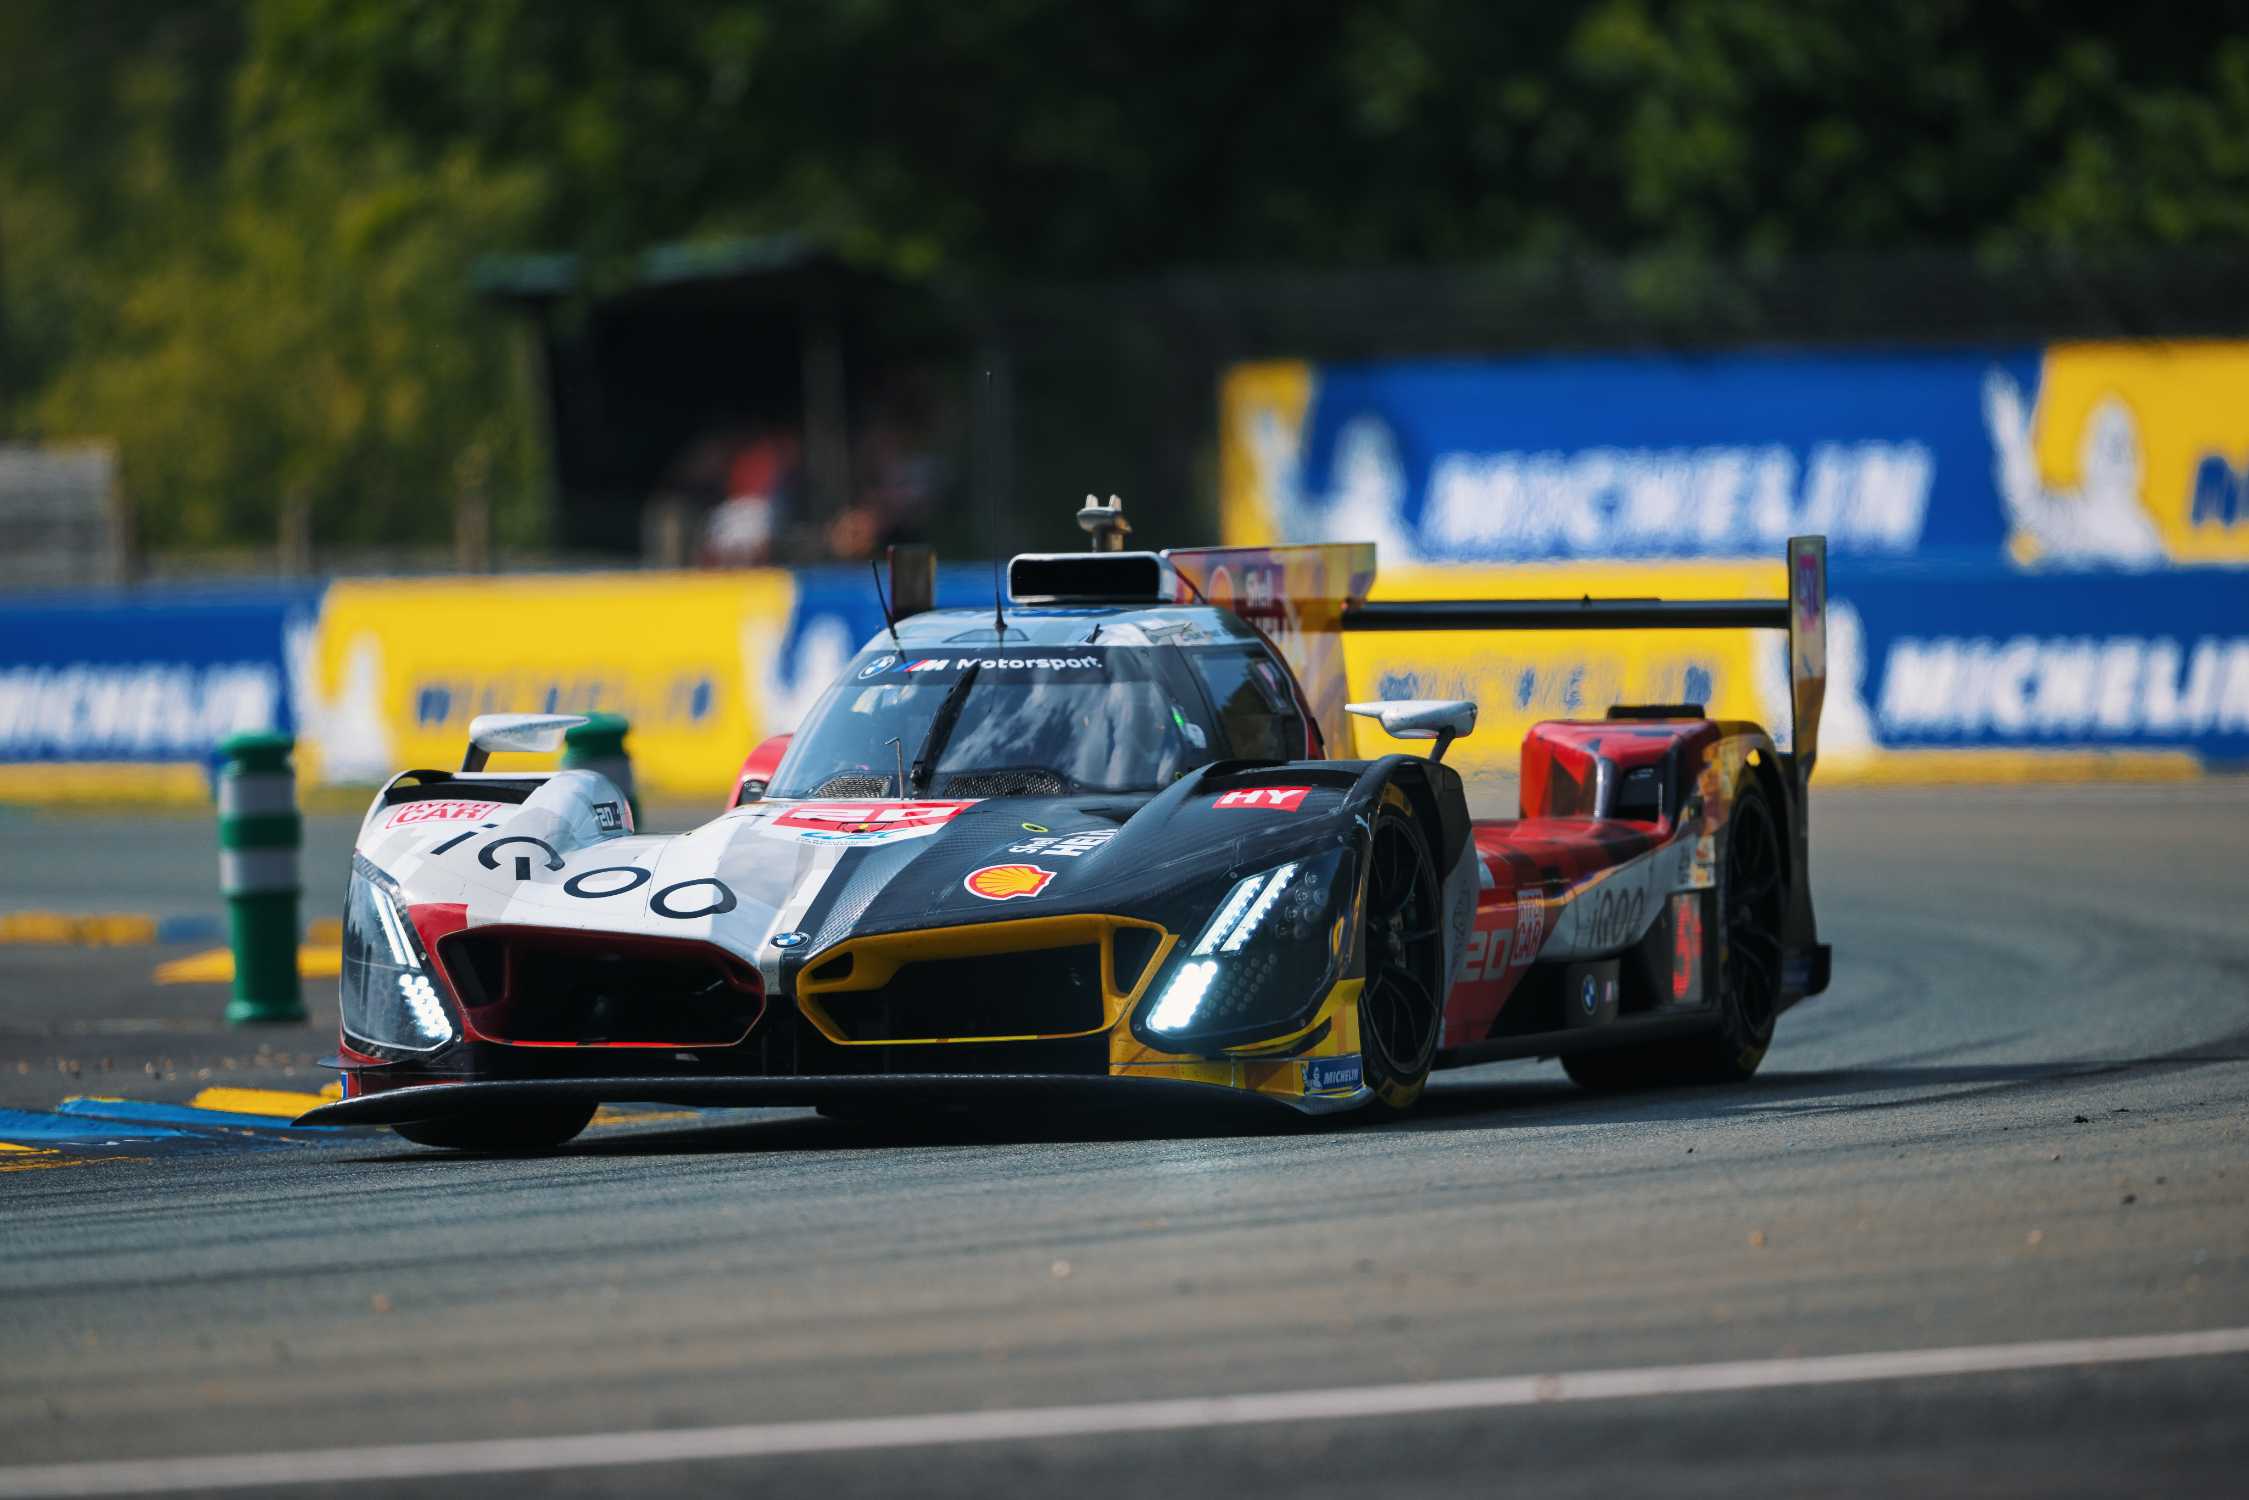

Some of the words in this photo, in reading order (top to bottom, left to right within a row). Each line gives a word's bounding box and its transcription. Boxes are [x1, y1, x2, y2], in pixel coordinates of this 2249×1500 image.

[1220, 789, 1304, 804] HY
[396, 808, 480, 823] CAR
[1456, 928, 1514, 983] 20
[1323, 1068, 1360, 1086] MICHELIN
